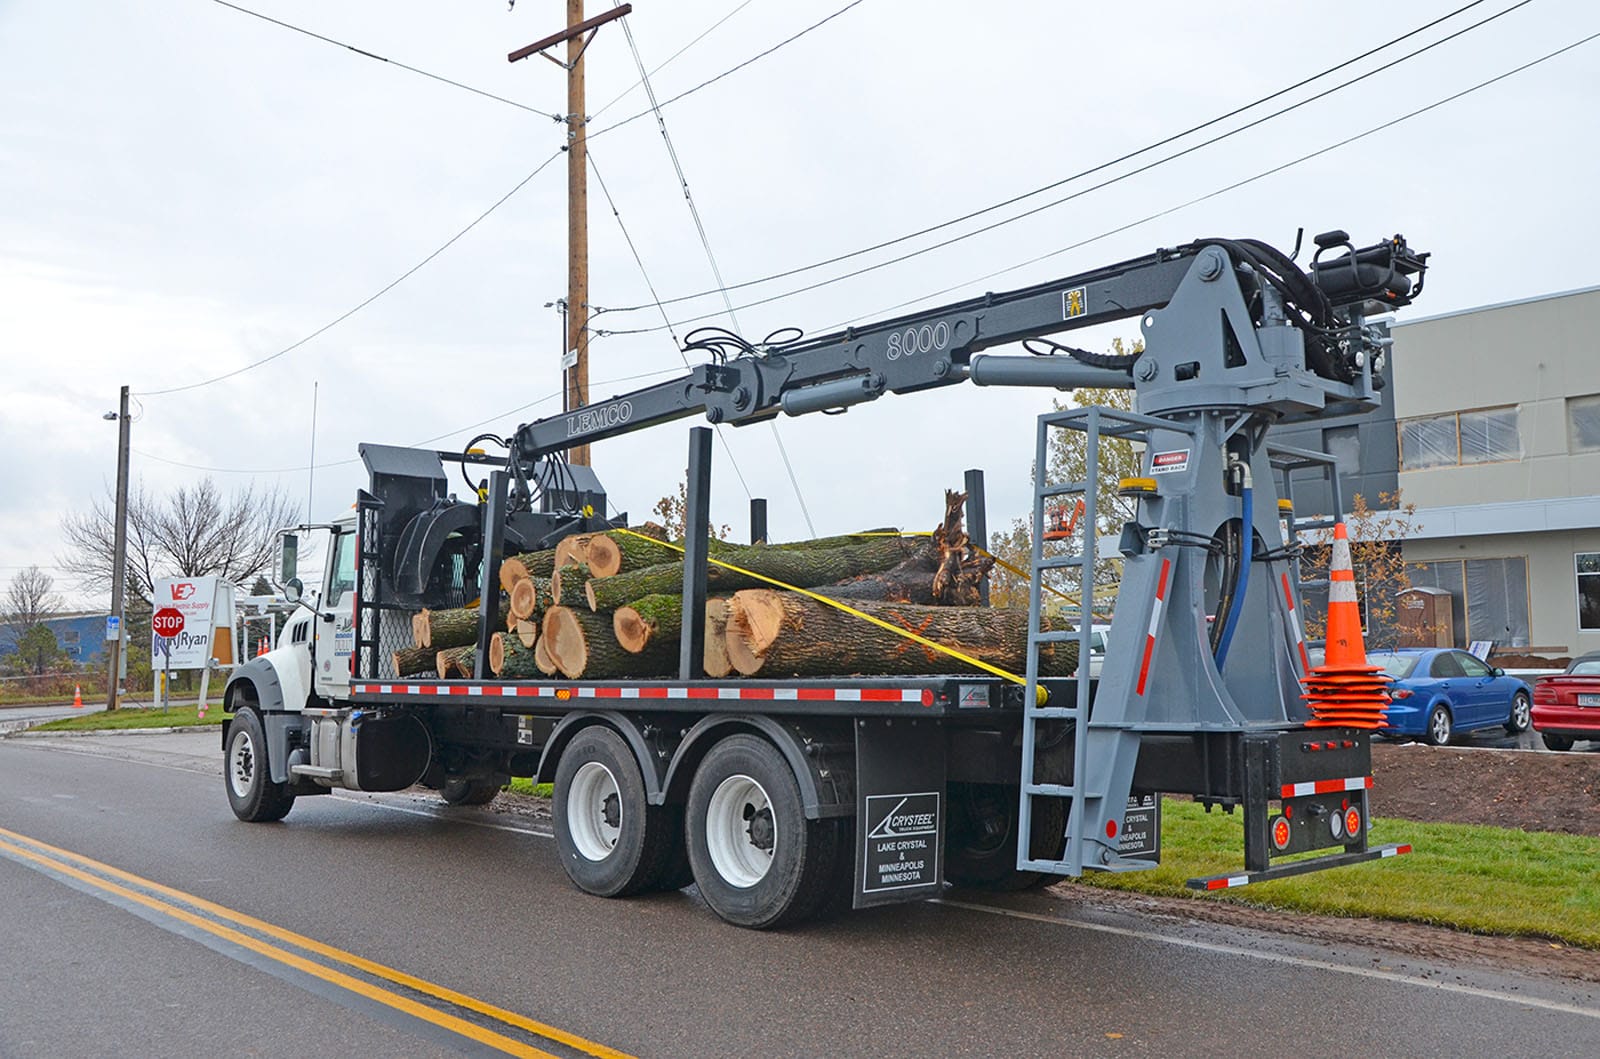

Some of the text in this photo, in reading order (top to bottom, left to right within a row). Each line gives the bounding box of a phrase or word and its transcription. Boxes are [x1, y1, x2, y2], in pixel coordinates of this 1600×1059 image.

[887, 321, 950, 361] 8000
[567, 400, 633, 438] LEMCO
[154, 616, 183, 629] STOP
[892, 814, 933, 827] CRYSTEEL
[877, 840, 927, 852] LAKE CRYSTAL
[899, 852, 905, 860] &
[879, 860, 925, 873] MINNEAPOLIS
[881, 871, 921, 883] MINNESOTA
